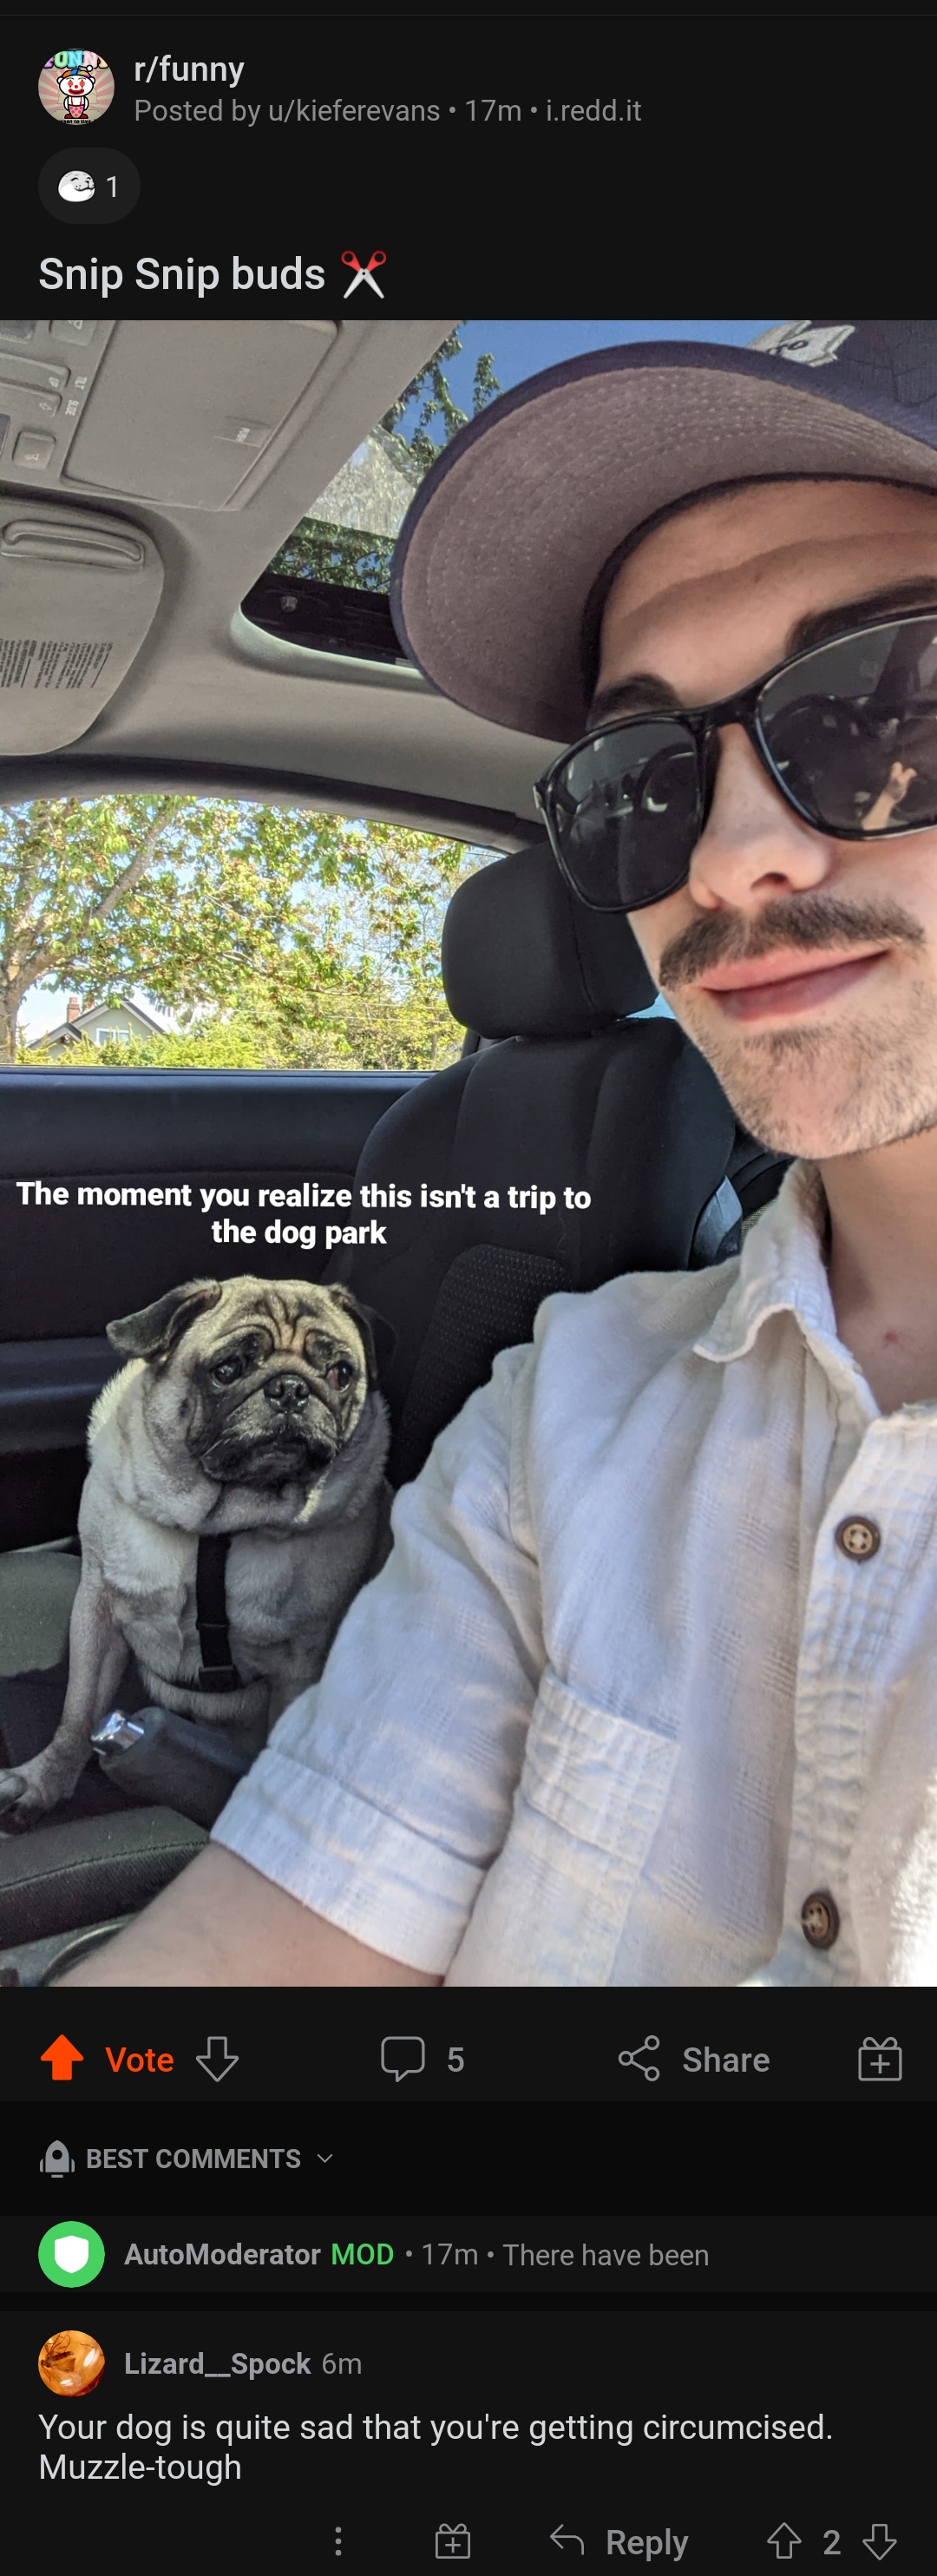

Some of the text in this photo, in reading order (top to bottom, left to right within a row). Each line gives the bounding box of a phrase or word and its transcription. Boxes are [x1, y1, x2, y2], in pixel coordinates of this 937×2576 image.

[135, 55, 245, 88] r/funny
[136, 99, 641, 128] Posted by u/kieferevans 17m i.redd.it
[106, 176, 116, 198] 1
[39, 256, 324, 298] Snip Snip buds
[75, 376, 88, 390] TILT
[105, 2047, 174, 2073] Vote
[447, 2047, 465, 2073] 5
[683, 2047, 770, 2073] Share
[87, 2148, 301, 2169] BEST COMMENTS
[124, 2243, 709, 2266] AutoModerator MOD 17m There have been
[322, 2353, 362, 2375] 6m
[38, 2414, 832, 2447] Your dog is quite sad that you're getting circumcised.
[40, 2454, 241, 2487] Muzzle-tough
[607, 2528, 690, 2562] Reply
[822, 2529, 842, 2555] 2
